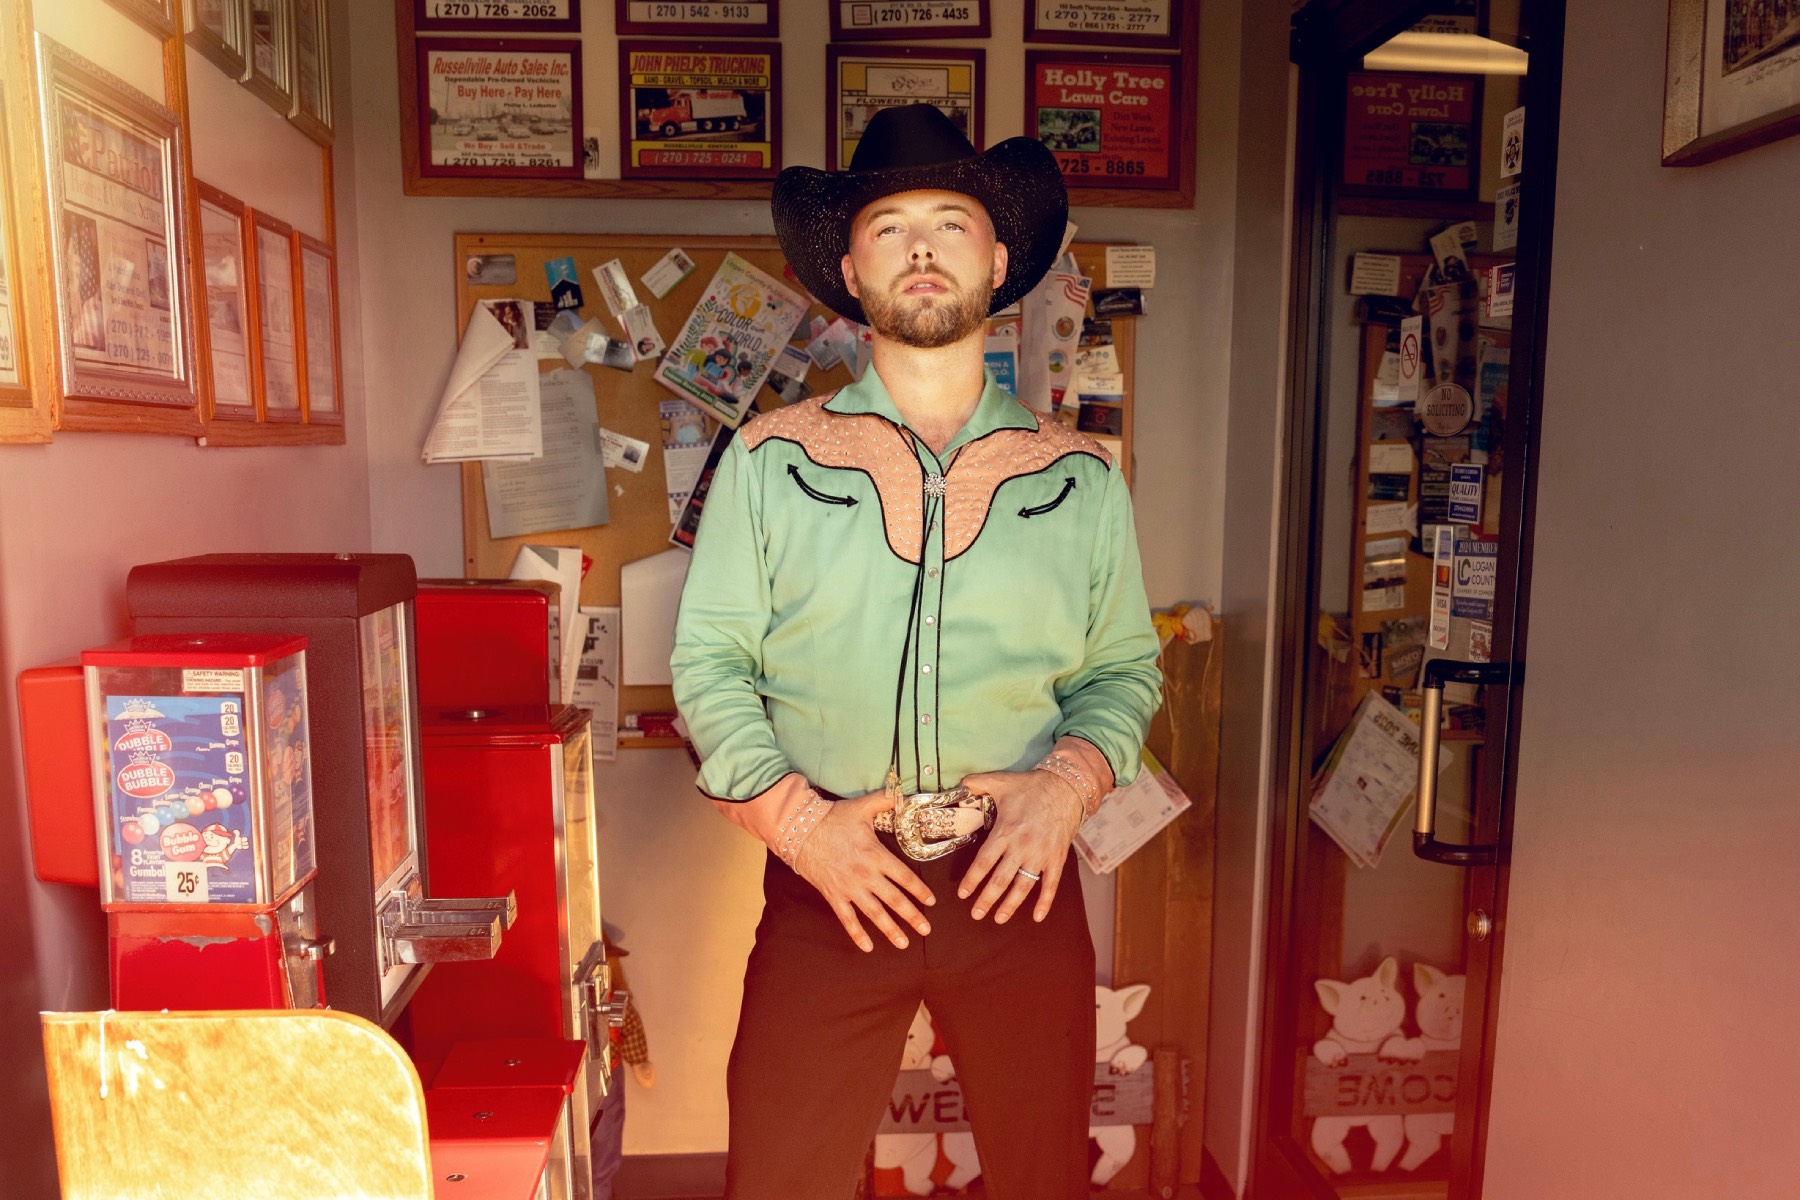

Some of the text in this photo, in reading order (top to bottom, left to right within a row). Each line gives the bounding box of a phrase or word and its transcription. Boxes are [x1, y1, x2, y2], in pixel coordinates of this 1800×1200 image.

[522, 5, 557, 17] 2062
[722, 6, 749, 18] 9133
[942, 8, 969, 20] 4435
[1128, 14, 1160, 23] 2777
[433, 57, 569, 76] Russellville Auto Sales Inc.
[632, 56, 765, 74] JOHN PHELPS TRUCKING
[1045, 69, 1165, 91] Holly Tree
[457, 85, 561, 100] Buy Here Pay Here
[1060, 89, 1149, 105] Lawn Care
[1061, 159, 1089, 173] 725
[1106, 161, 1144, 175] 8865
[717, 307, 753, 331] COLOR
[1441, 389, 1452, 401] NO
[1427, 404, 1465, 417] SOLICITING
[1452, 484, 1478, 496] QUALITY
[1472, 561, 1495, 572] LOGAN
[1436, 598, 1447, 609] VISA
[224, 704, 234, 713] 20
[225, 716, 235, 725] 20
[118, 735, 164, 751] DUBBLE
[230, 755, 239, 763] 20
[121, 768, 167, 782] DUBBLE
[125, 777, 171, 791] BUBBLE
[163, 832, 199, 847] Bubble
[172, 844, 196, 856] Gum
[130, 848, 143, 866] 8
[177, 872, 199, 893] 25¢
